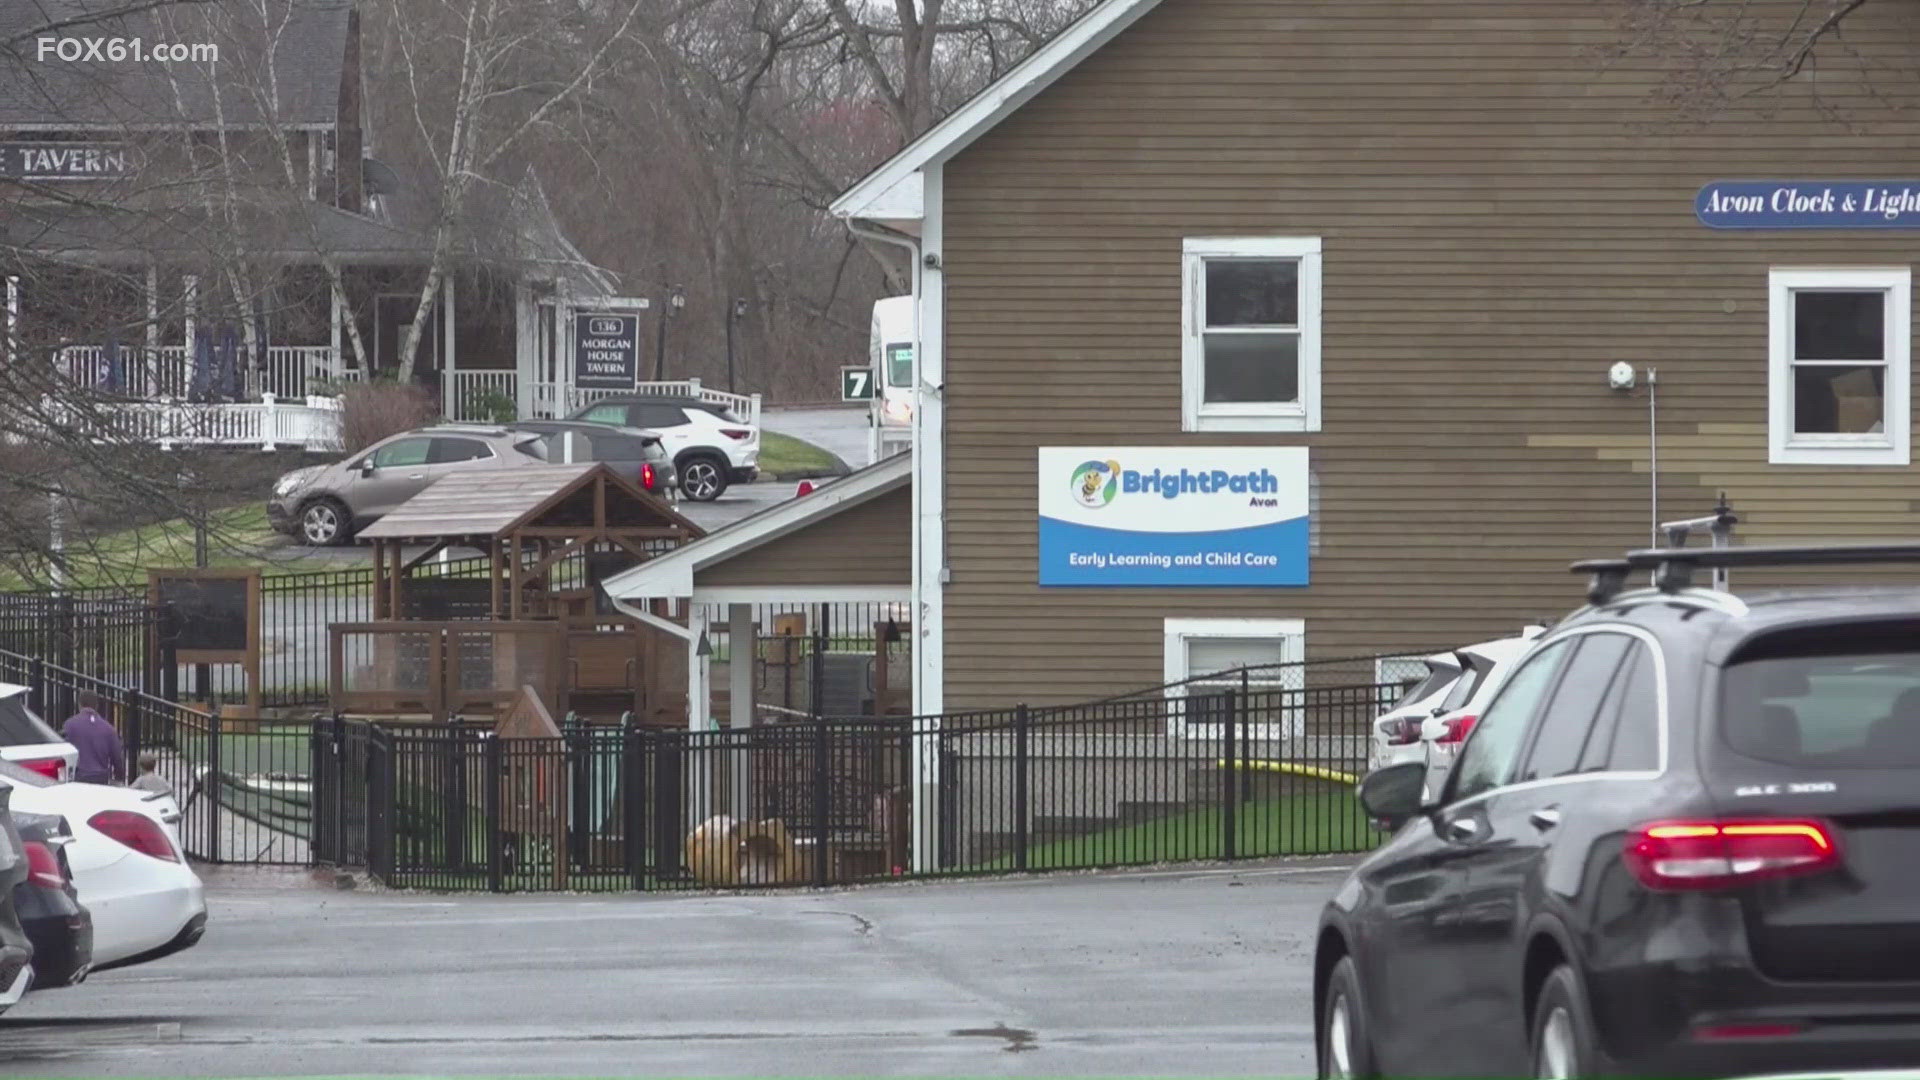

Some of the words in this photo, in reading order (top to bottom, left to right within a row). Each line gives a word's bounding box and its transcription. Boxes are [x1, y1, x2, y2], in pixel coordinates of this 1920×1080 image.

[19, 148, 125, 173] TAVERN
[1703, 189, 1763, 213] Avon
[1771, 188, 1836, 213] Clock
[1841, 193, 1857, 213] &
[597, 321, 617, 332] 136
[582, 339, 631, 349] MORGAN
[587, 351, 624, 361] HOUSE
[586, 362, 625, 373] TAVERN
[849, 372, 868, 397] 7
[1122, 468, 1278, 500] BrightPath
[1249, 497, 1278, 508] Avon
[1069, 553, 1106, 568] Early
[1109, 553, 1171, 569] Learning
[1175, 553, 1202, 566] and
[1205, 553, 1241, 566] Child
[1244, 553, 1278, 566] Care
